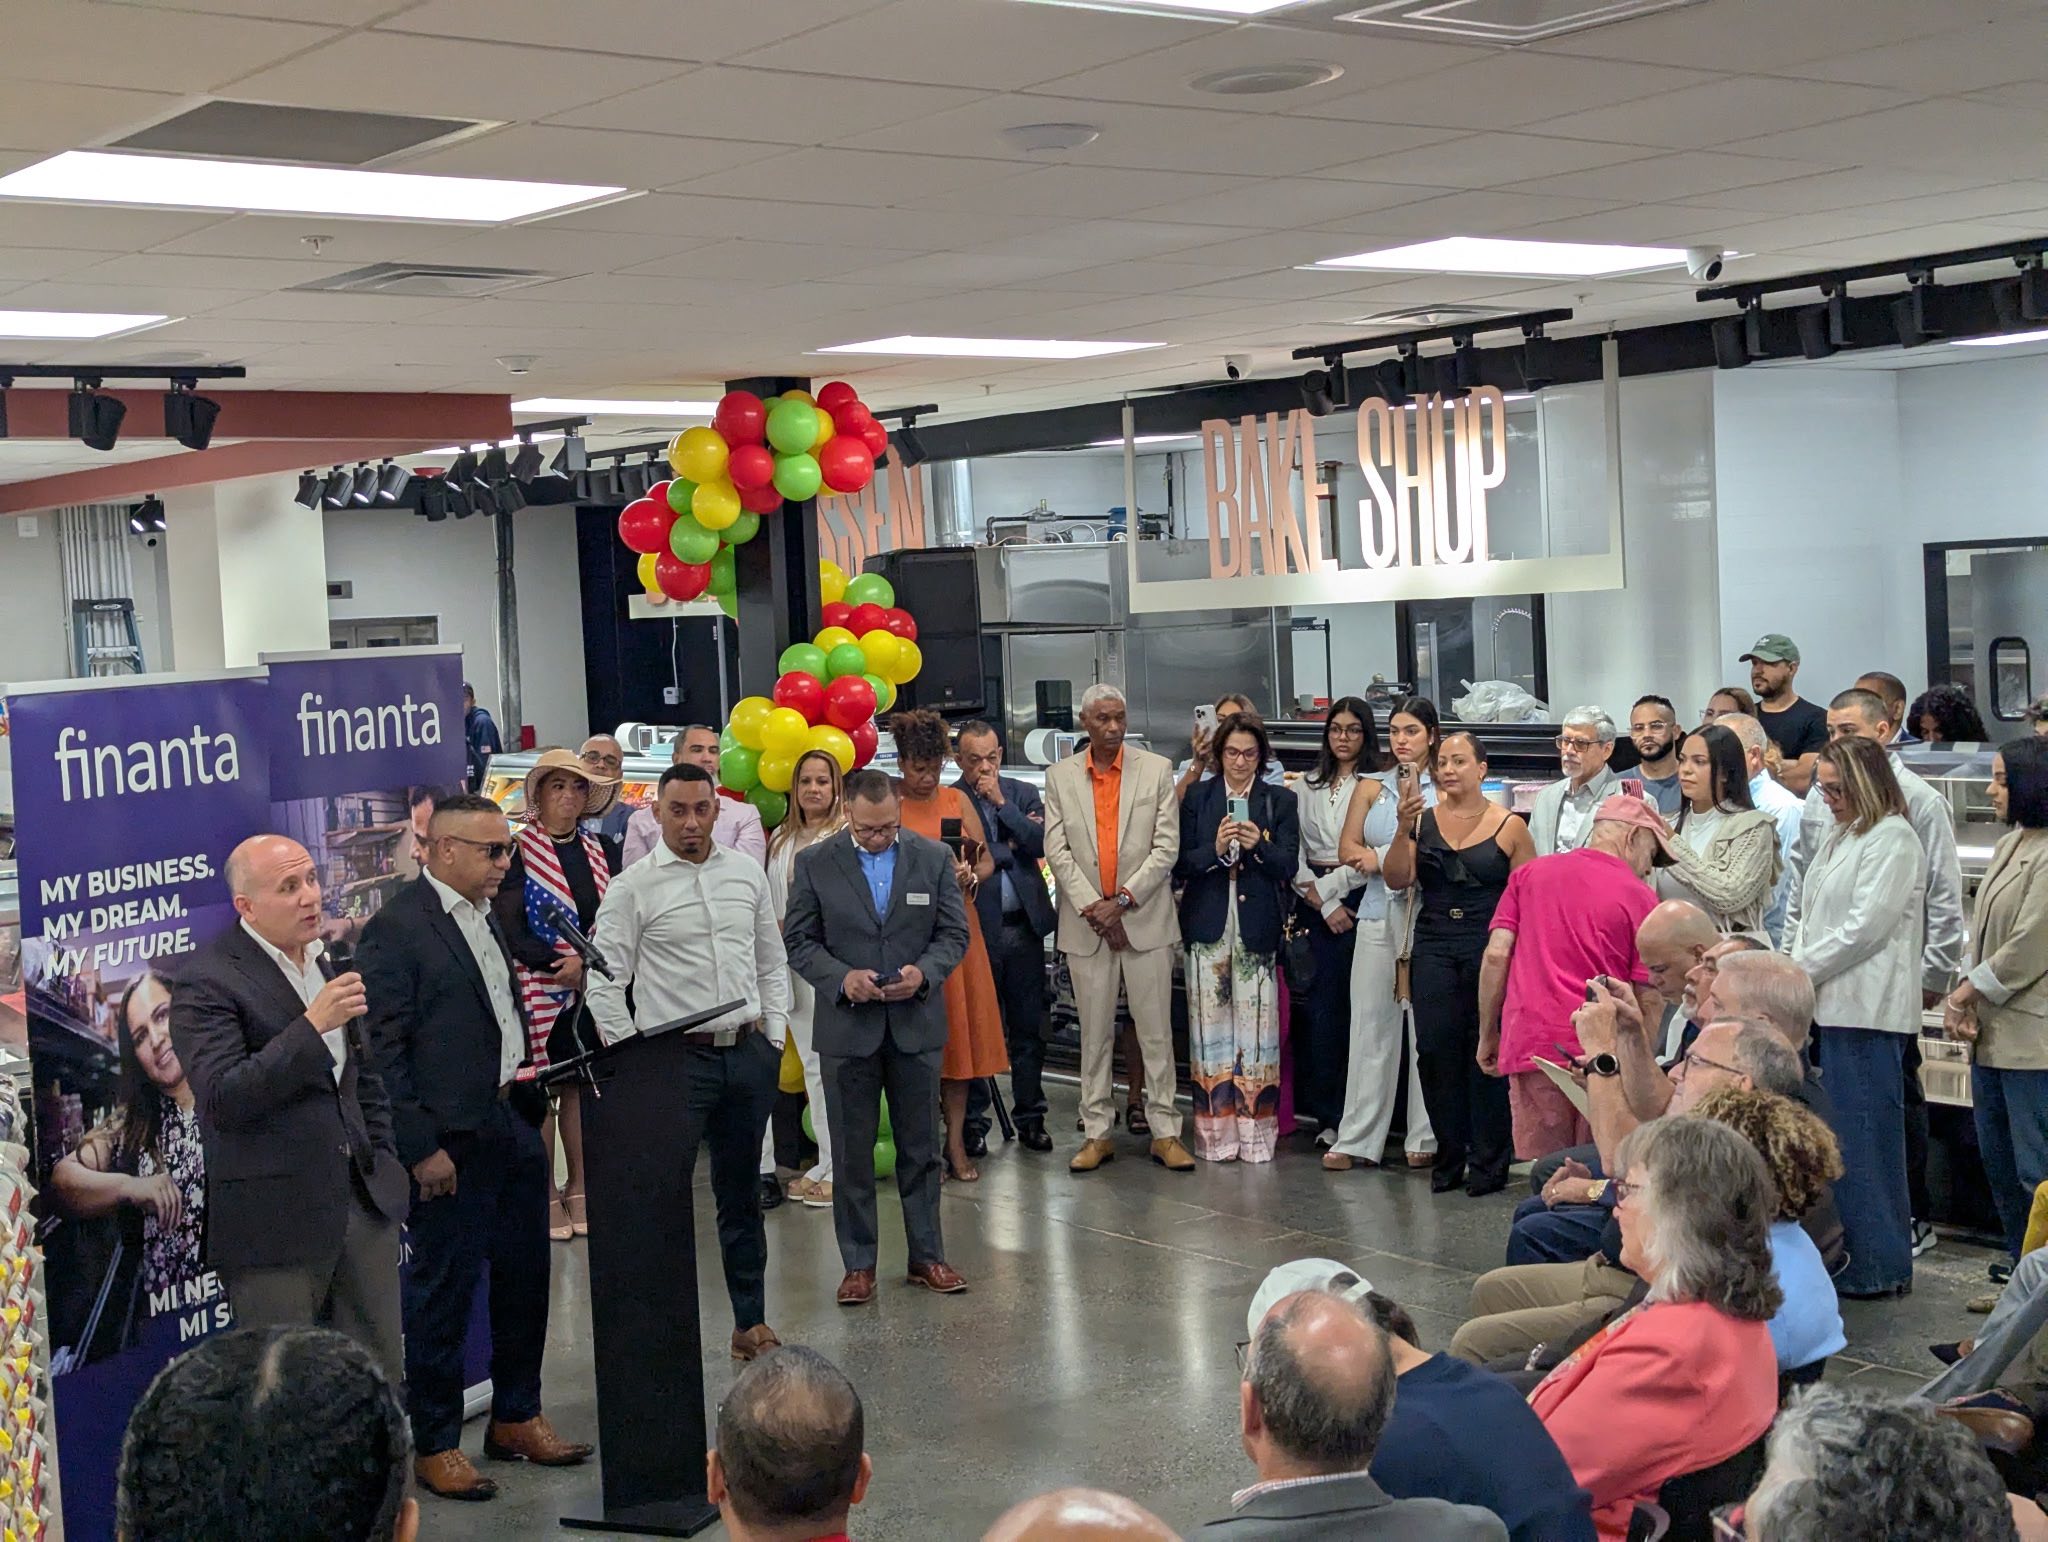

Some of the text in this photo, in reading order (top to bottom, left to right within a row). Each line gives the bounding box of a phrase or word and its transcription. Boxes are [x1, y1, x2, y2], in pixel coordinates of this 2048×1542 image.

[1202, 384, 1507, 580] BAKE SHOP
[297, 692, 441, 757] finanta
[54, 725, 240, 801] finanta
[40, 854, 215, 906] MY BUSINESS.
[43, 894, 188, 943] MY DREAM.
[47, 927, 196, 980] MY FUTURE.
[149, 1284, 178, 1318] MI
[179, 1302, 234, 1342] MI S
